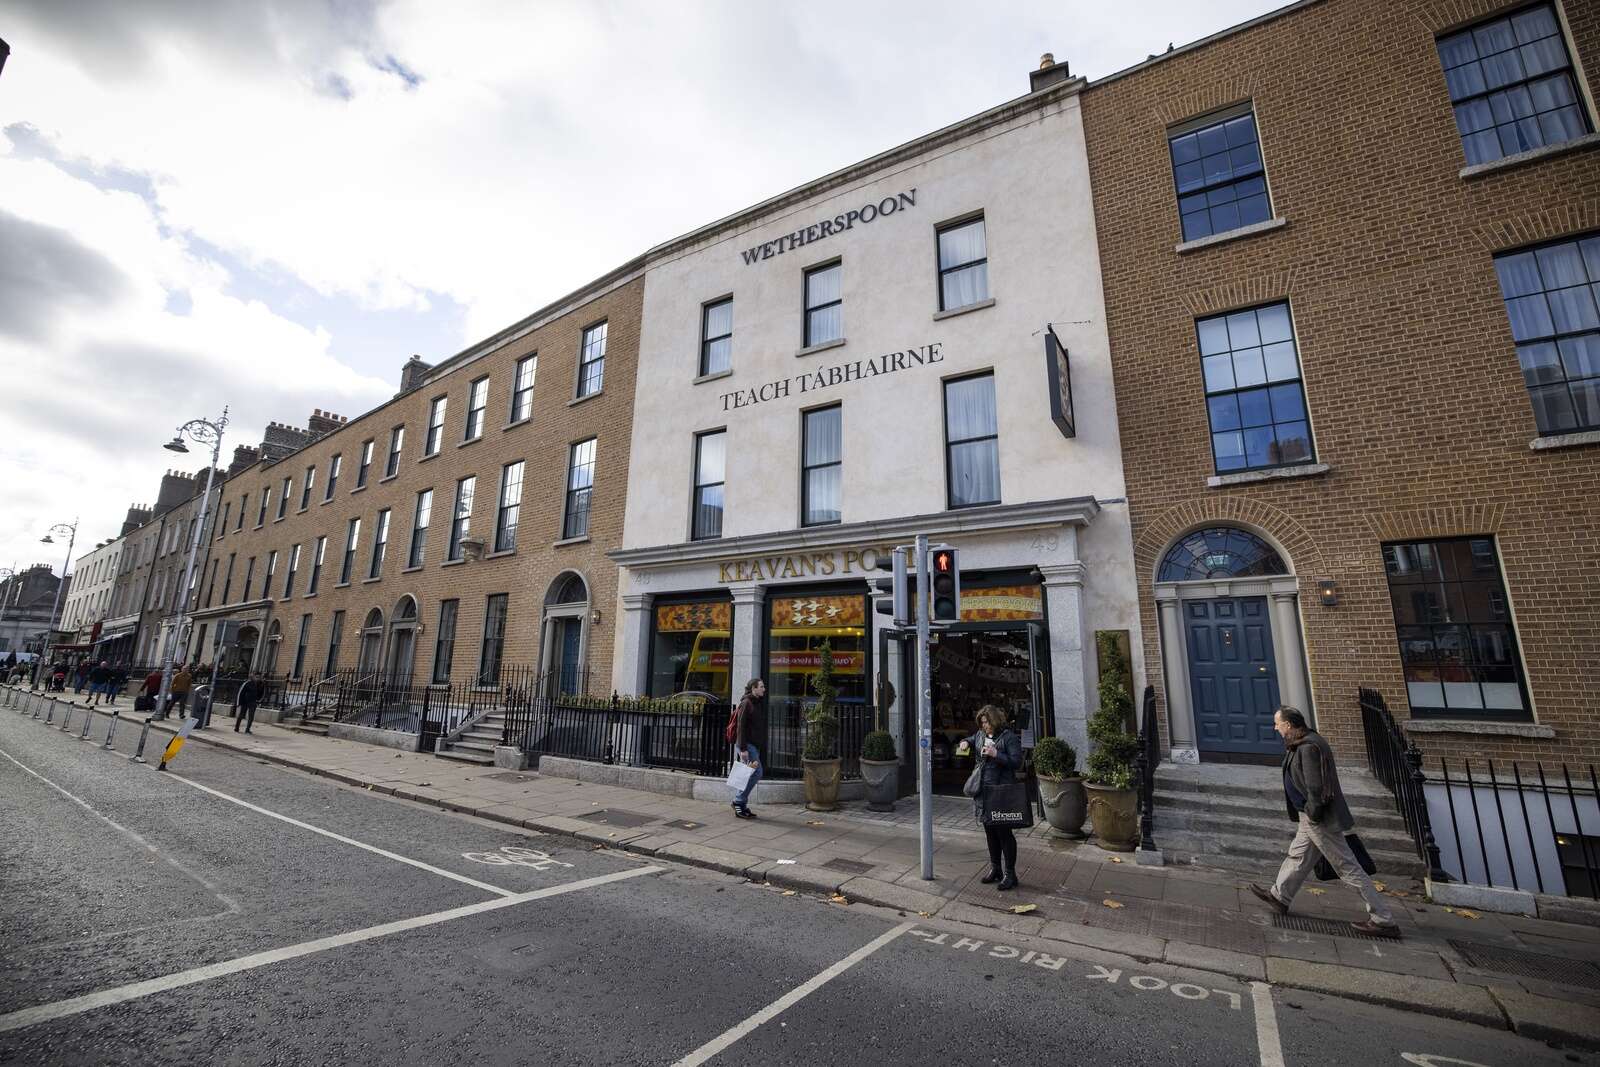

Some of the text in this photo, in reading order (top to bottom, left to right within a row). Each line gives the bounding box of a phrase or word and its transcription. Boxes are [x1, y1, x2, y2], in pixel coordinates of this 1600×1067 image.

[741, 188, 917, 266] WETHERSPOON
[719, 342, 944, 411] TEACH TÁBHAIRNE
[719, 551, 835, 583] KEAVAN'S
[1031, 533, 1059, 552] 49
[924, 933, 1241, 1010] LOOK RIGHT
